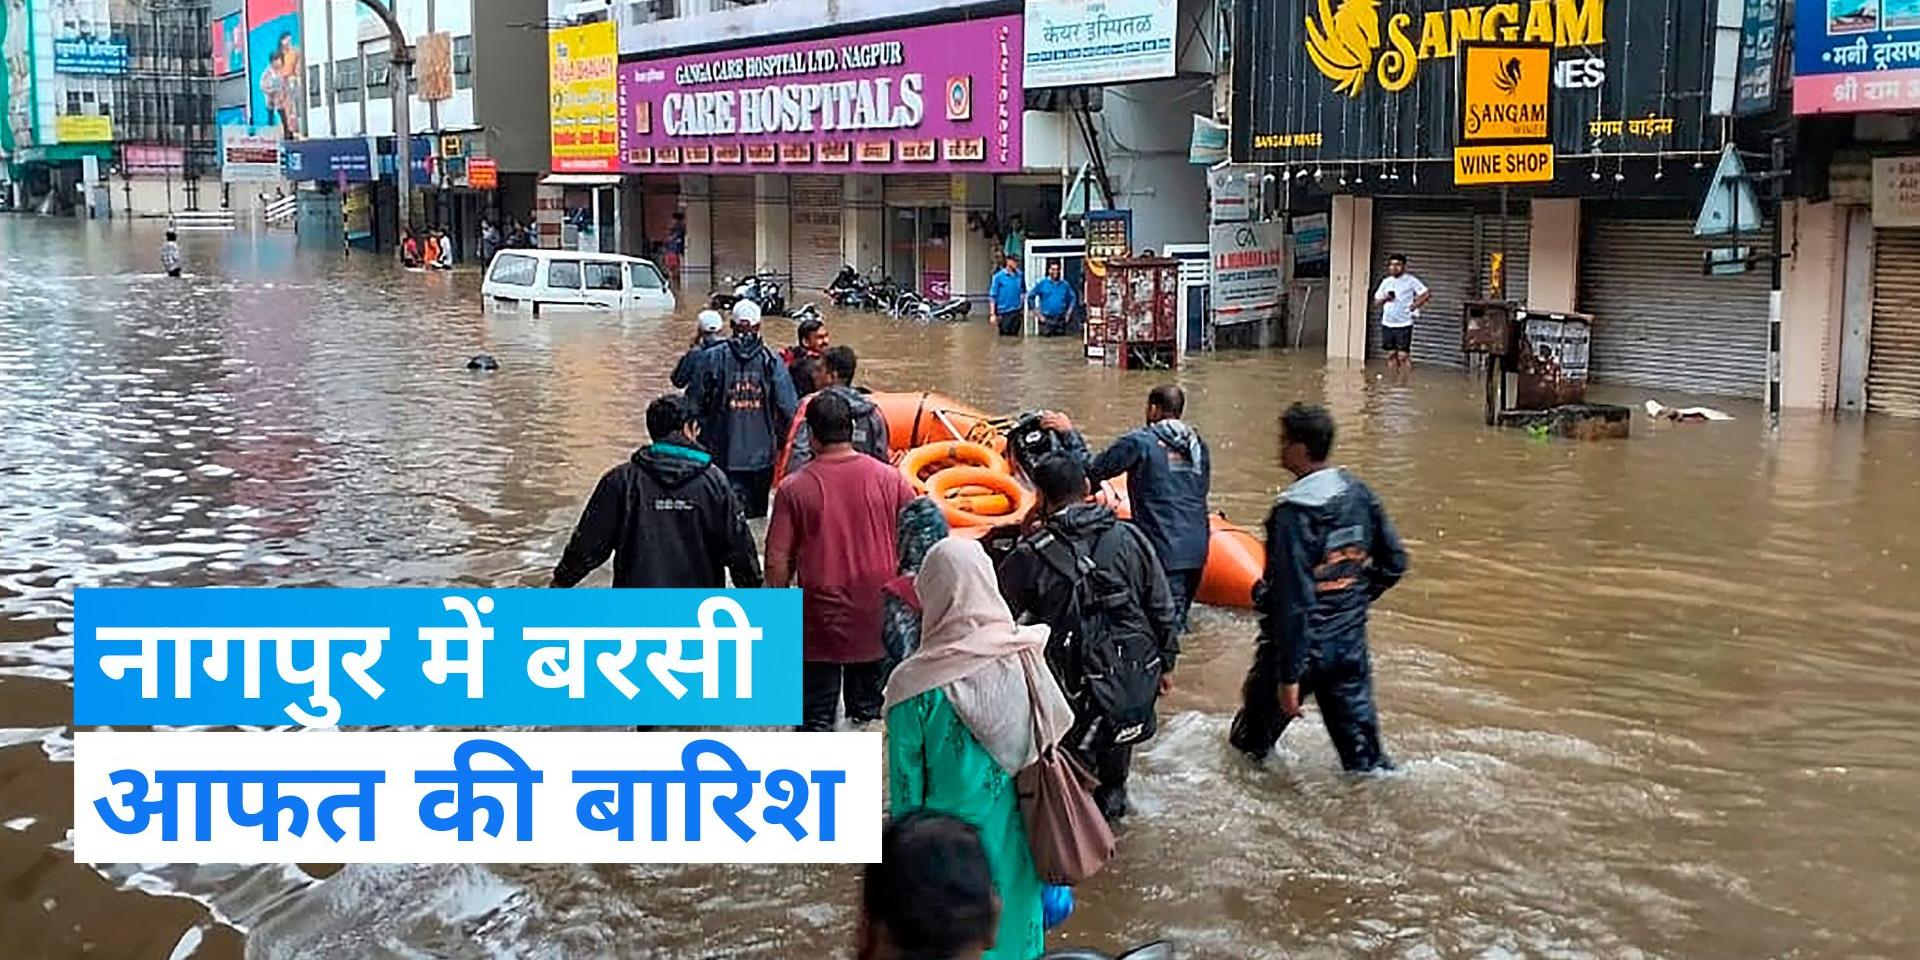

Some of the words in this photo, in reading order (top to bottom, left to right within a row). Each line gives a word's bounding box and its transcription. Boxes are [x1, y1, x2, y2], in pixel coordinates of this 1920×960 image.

[1043, 19, 1082, 44] केयर
[1377, 0, 1605, 91] SANGAM
[676, 61, 713, 85] GANGA
[713, 57, 745, 82] CARE
[745, 49, 807, 78] HOSPITAL
[808, 48, 840, 73] LTD.
[841, 41, 903, 69] NAGPUR
[1833, 35, 1869, 66] मनी
[662, 91, 737, 136] CARE
[738, 73, 924, 134] HOSPITALS
[1466, 103, 1545, 134] SANGAM
[1461, 155, 1501, 175] WINE
[1506, 153, 1548, 173] SHOP
